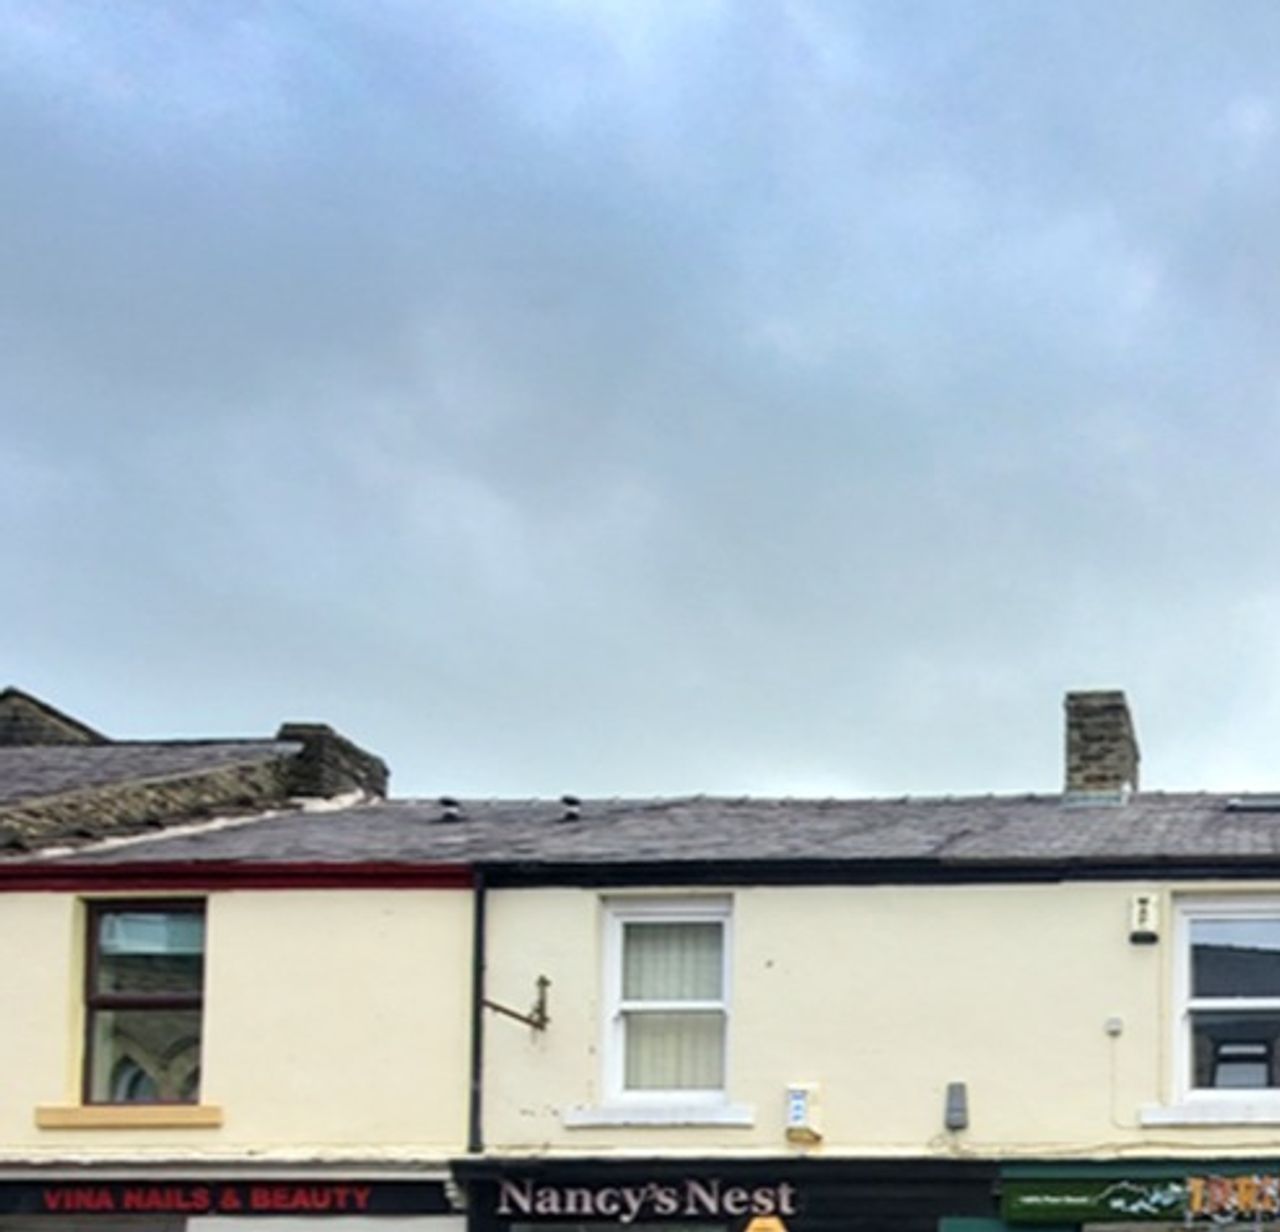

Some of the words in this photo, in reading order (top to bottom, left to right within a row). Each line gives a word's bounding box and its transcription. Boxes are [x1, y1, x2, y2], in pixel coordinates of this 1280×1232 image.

[44, 1187, 114, 1210] VINA
[124, 1187, 210, 1210] NAILS
[219, 1187, 241, 1209] &
[251, 1186, 372, 1209] BEAUTY
[496, 1178, 679, 1223] Nancy's
[684, 1177, 797, 1215] Nest
